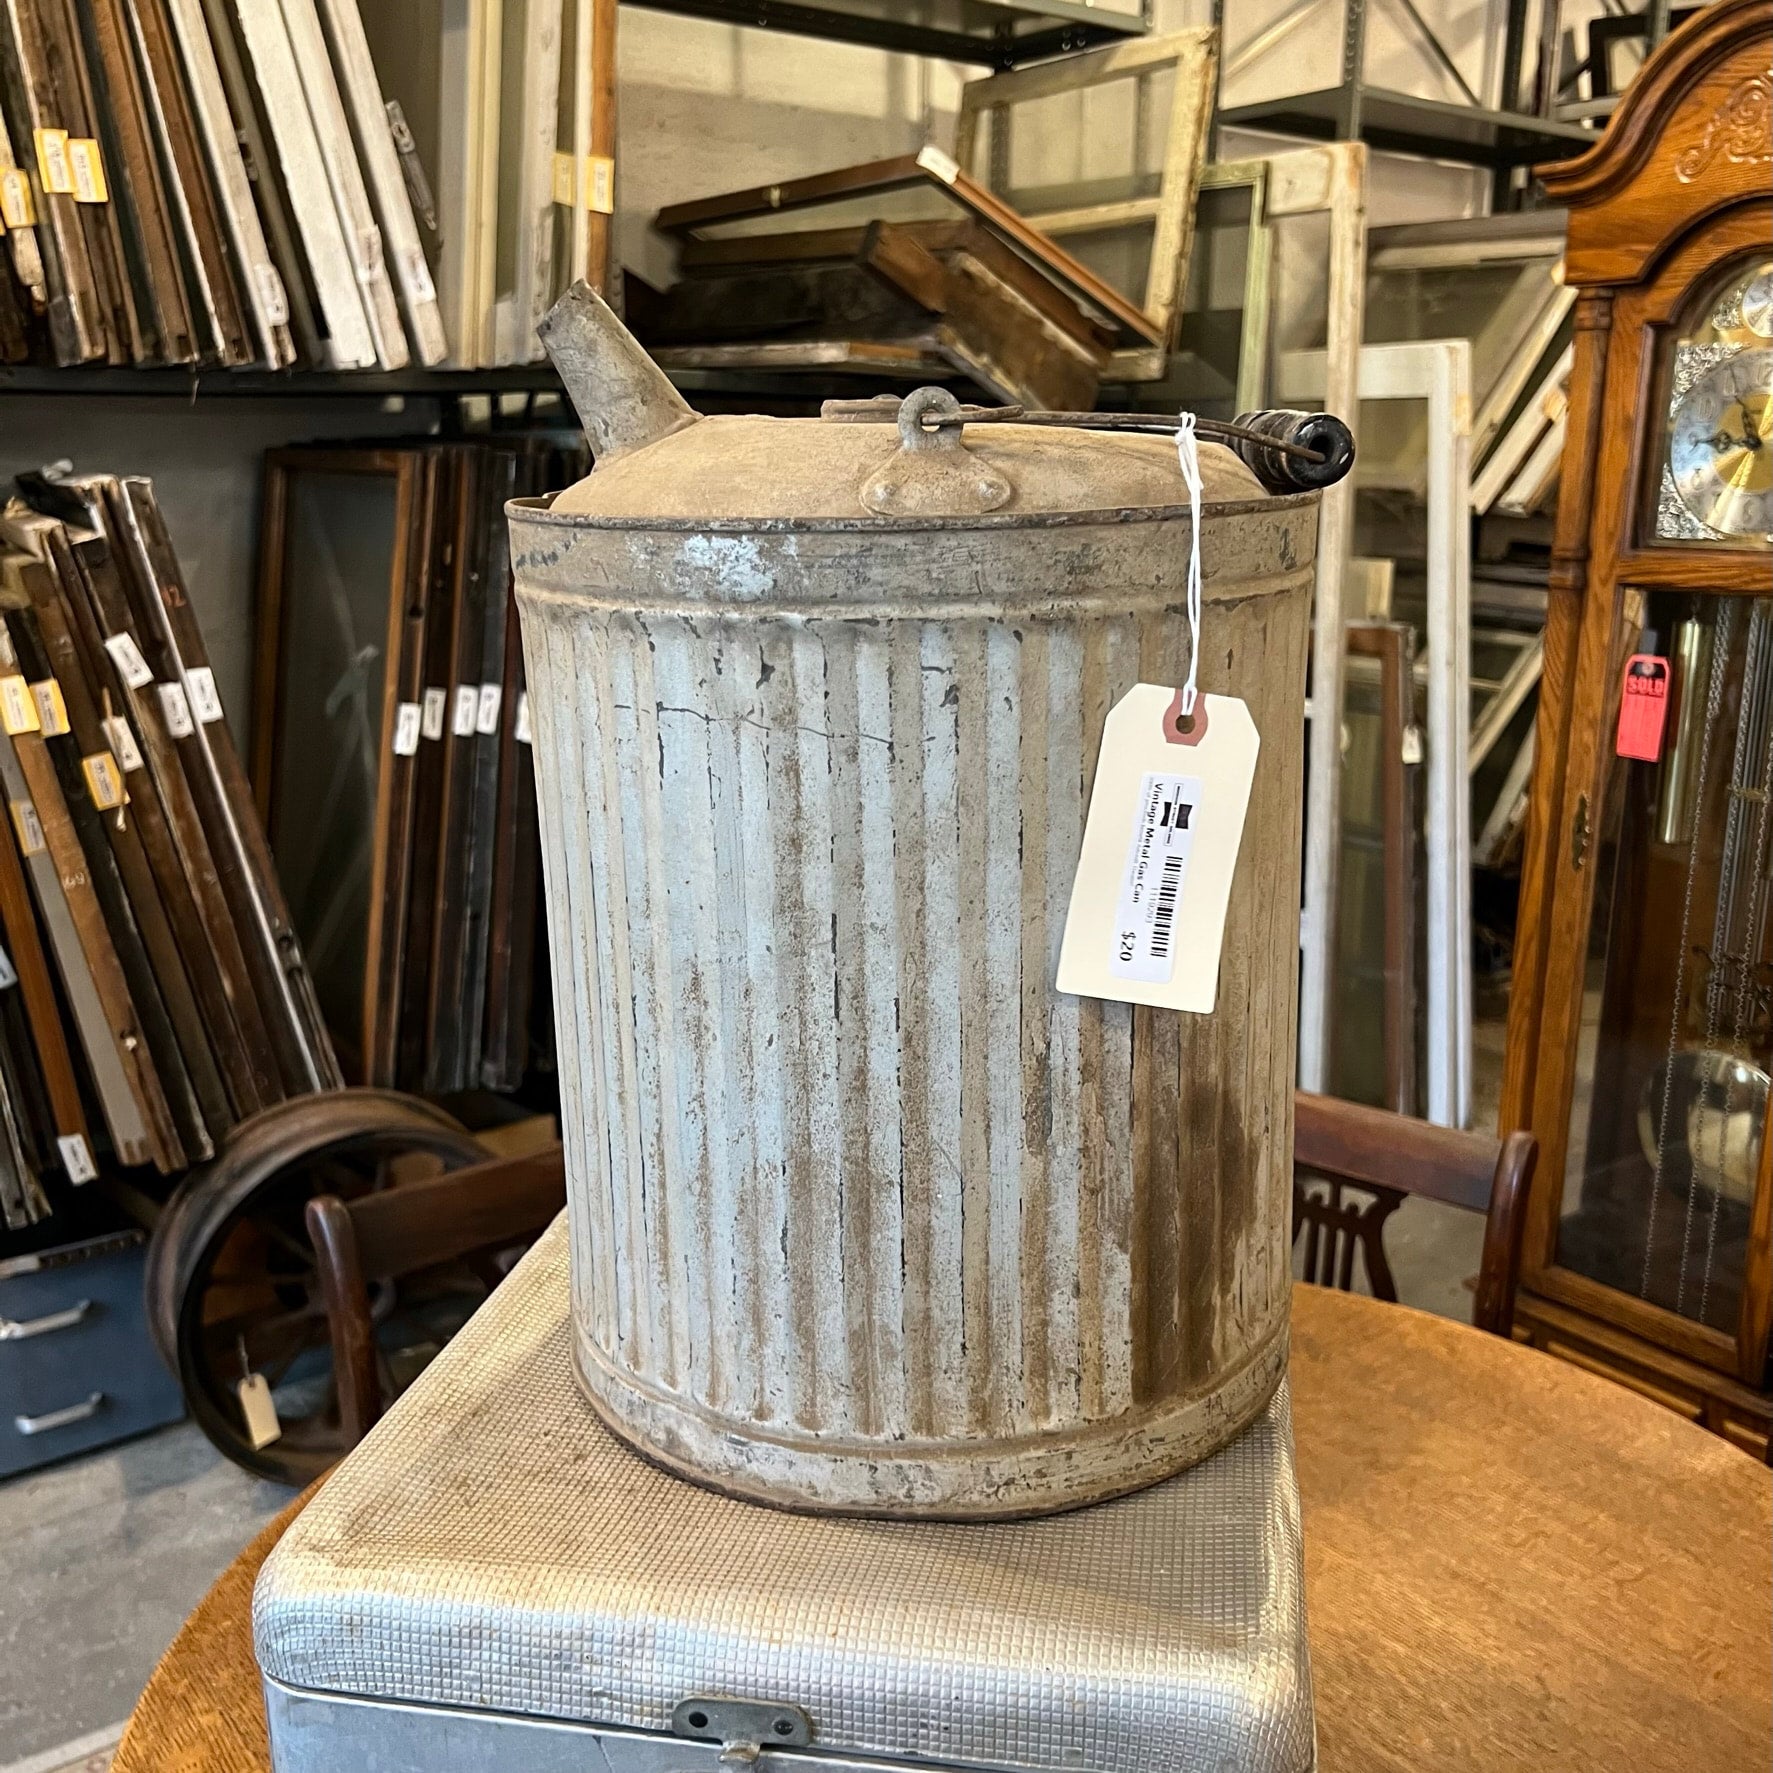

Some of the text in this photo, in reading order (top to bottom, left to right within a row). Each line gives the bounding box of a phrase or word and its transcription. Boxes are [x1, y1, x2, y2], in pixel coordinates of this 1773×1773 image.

[1627, 675, 1665, 698] SOLD
[1146, 783, 1164, 825] Vintage
[1141, 828, 1155, 859] Metal
[1137, 861, 1148, 881] Gas
[1132, 883, 1144, 904] Can
[1119, 931, 1136, 962] $20
